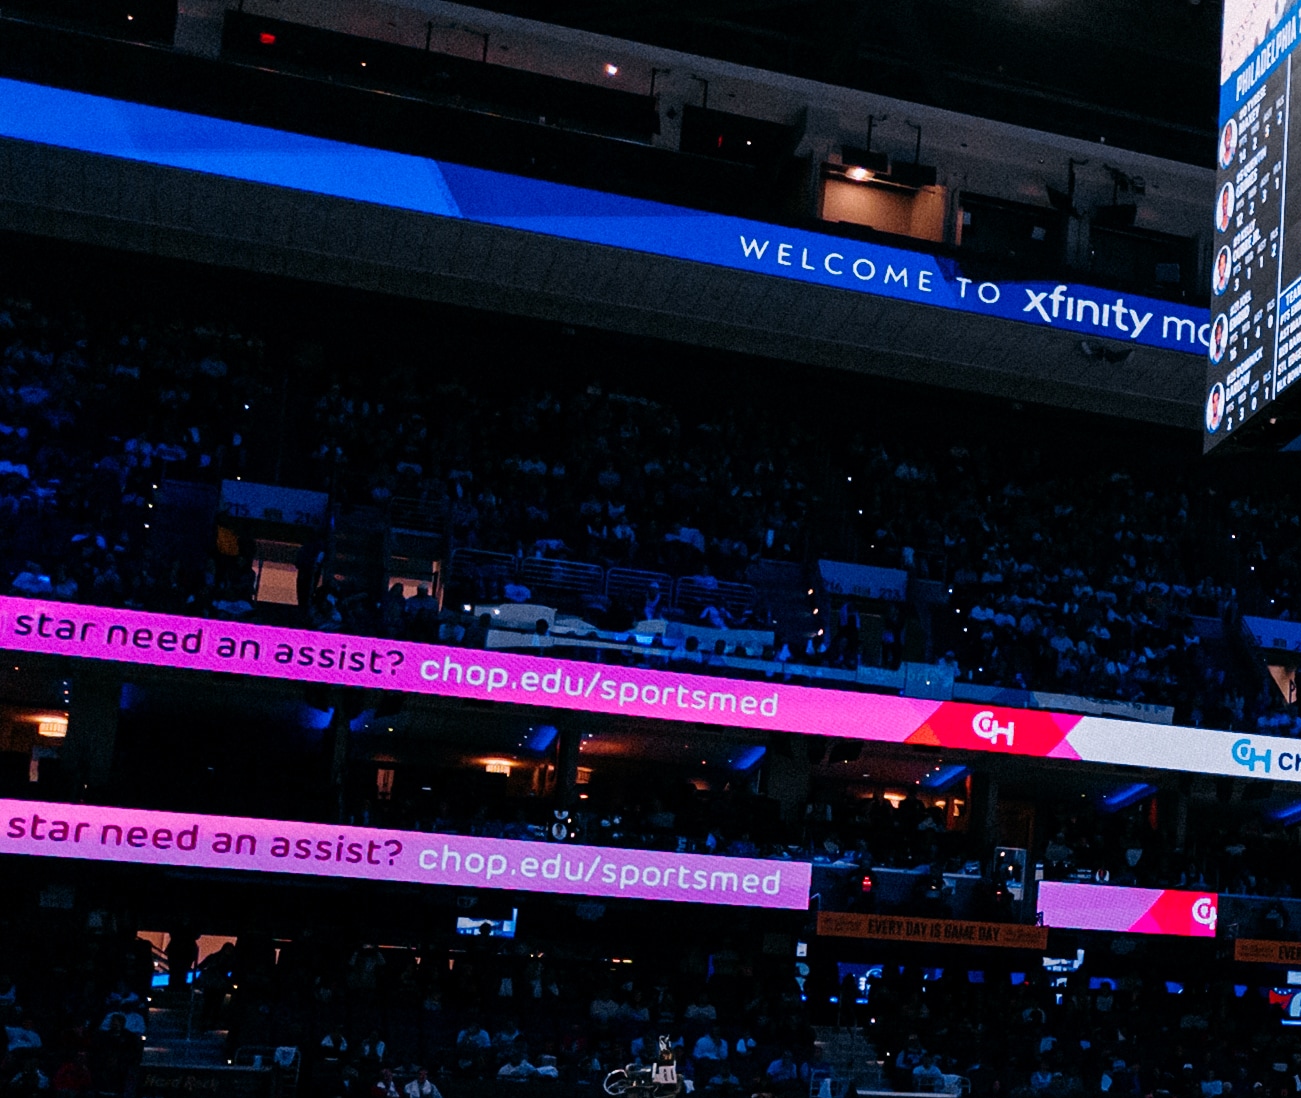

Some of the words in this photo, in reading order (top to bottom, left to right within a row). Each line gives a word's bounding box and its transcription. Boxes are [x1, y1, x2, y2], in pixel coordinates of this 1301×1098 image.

[1235, 19, 1297, 102] PHILADELPHIA
[739, 235, 934, 291] WELCOME
[955, 276, 1000, 304] TO
[1022, 284, 1153, 339] xfinity
[14, 608, 95, 645] star
[107, 621, 202, 655] need
[217, 634, 261, 662] an
[274, 637, 405, 677] assist?
[420, 656, 780, 720] chop.edu/sportsmed
[6, 812, 90, 843] star
[100, 819, 197, 853] need
[212, 830, 257, 858] an
[271, 830, 403, 867] assist?
[418, 844, 782, 897] chop.edu/sportsmed
